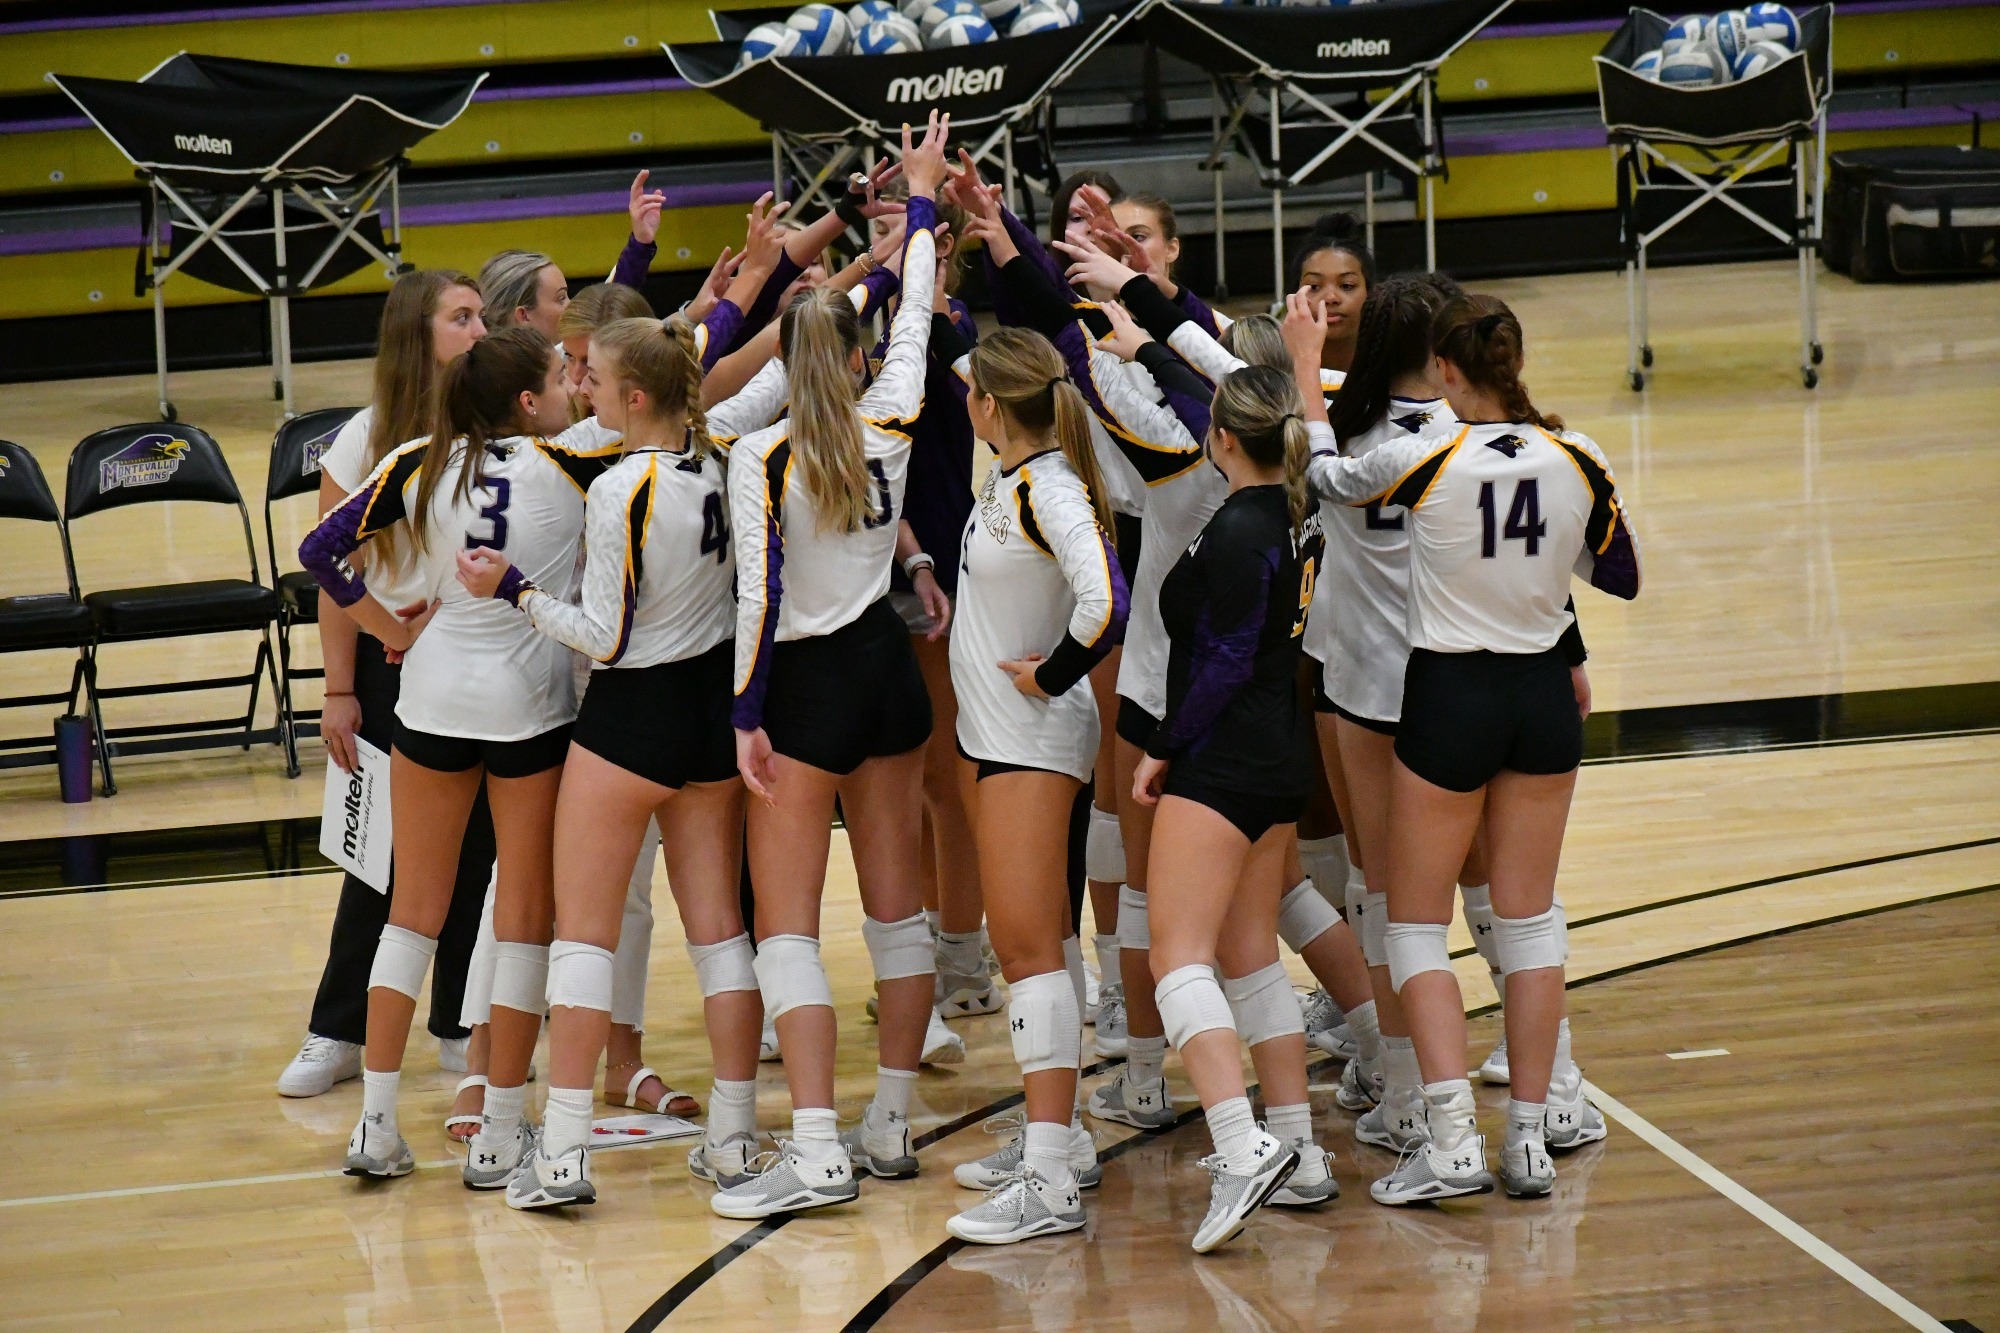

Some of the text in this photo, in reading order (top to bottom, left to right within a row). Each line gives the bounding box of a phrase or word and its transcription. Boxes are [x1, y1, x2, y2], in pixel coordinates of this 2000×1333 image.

[1317, 38, 1390, 58] molten
[886, 65, 1005, 103] molten
[174, 133, 232, 155] molten
[102, 459, 176, 489] MONTEVALLO
[126, 471, 167, 484] FALCONS
[465, 476, 511, 551] 3
[701, 489, 730, 565] 4
[1477, 477, 1547, 559] 14
[1289, 556, 1315, 639] 9
[343, 765, 364, 860] molten
[357, 849, 365, 870] For
